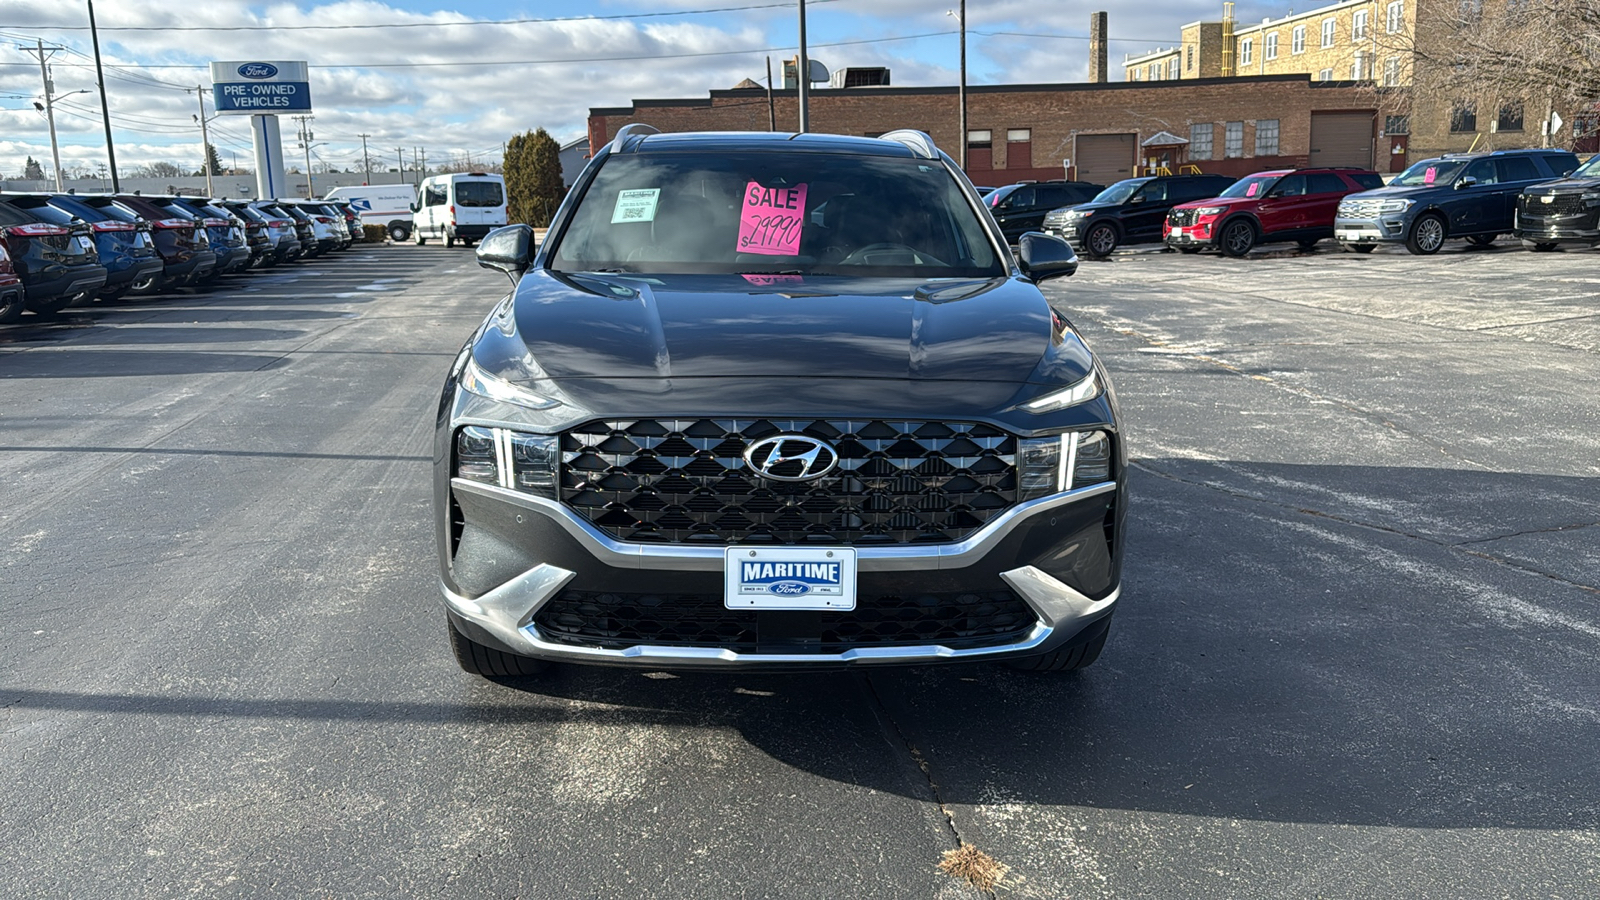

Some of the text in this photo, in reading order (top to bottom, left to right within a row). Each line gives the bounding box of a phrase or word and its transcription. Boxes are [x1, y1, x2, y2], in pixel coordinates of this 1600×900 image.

[245, 65, 268, 76] Ford
[233, 96, 289, 107] VEHICLES
[748, 186, 799, 210] SALE
[744, 563, 838, 582] MARITIME
[776, 583, 802, 594] Ford
